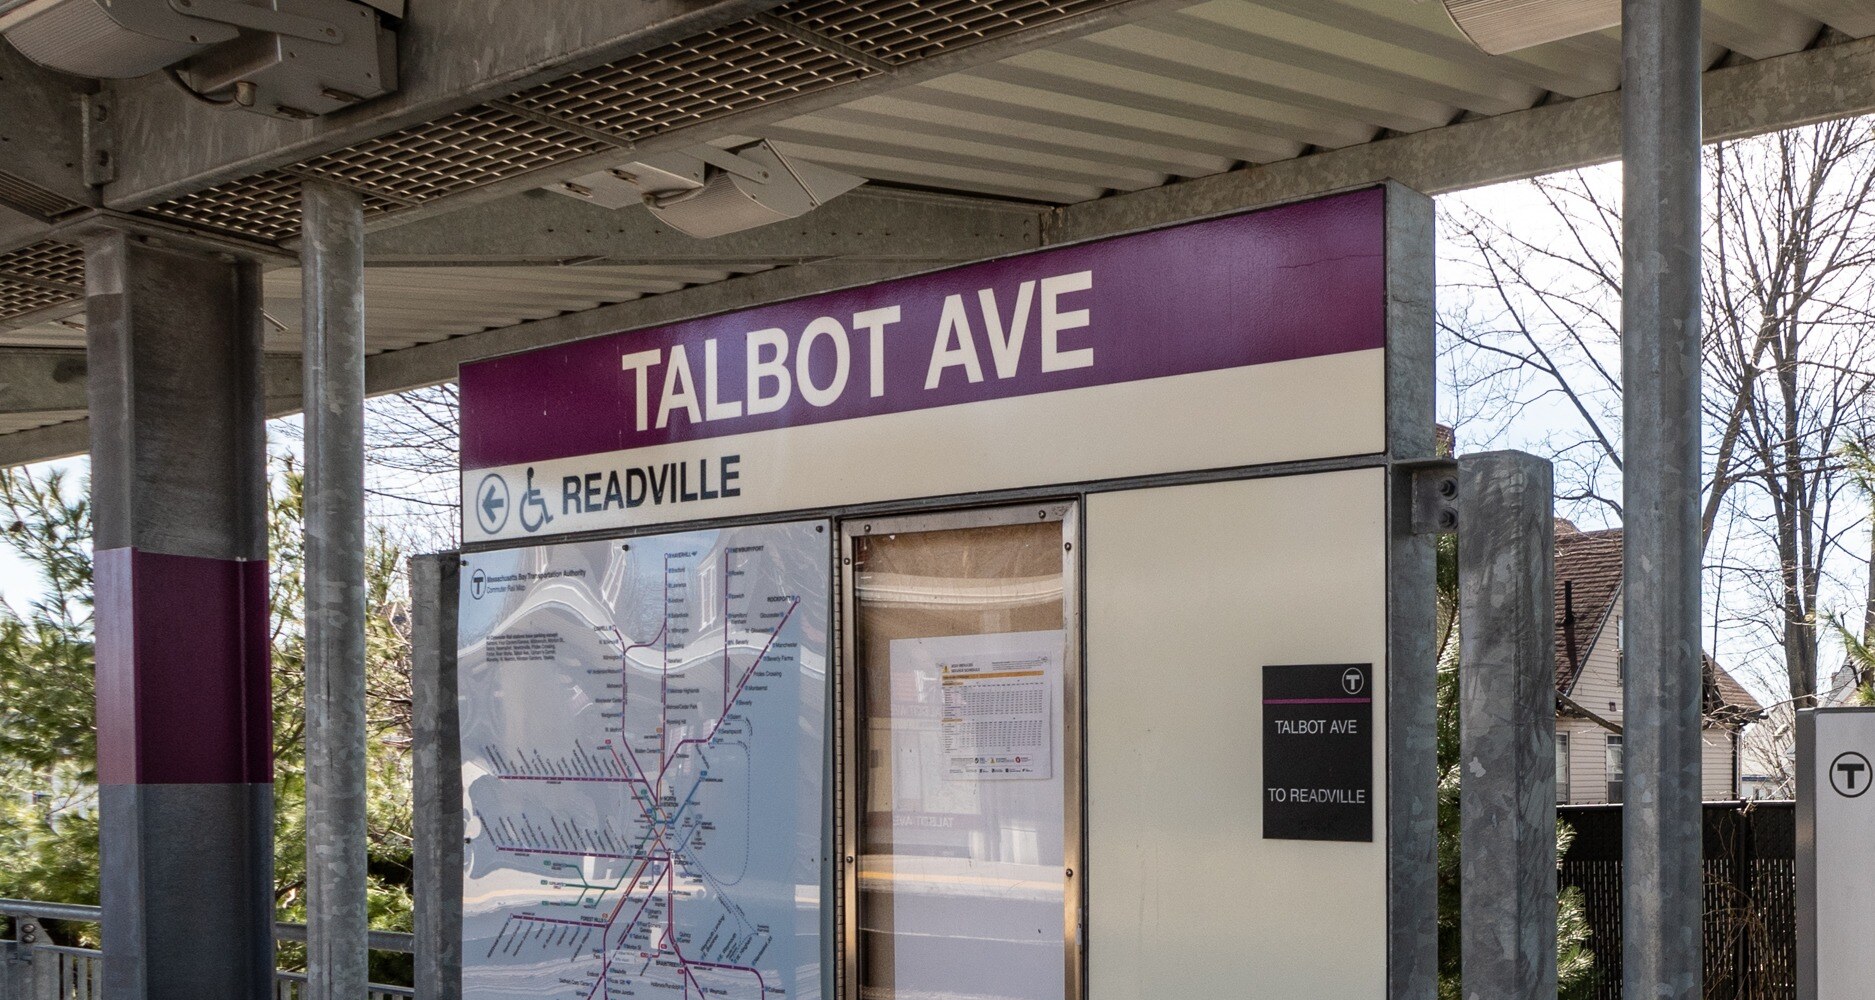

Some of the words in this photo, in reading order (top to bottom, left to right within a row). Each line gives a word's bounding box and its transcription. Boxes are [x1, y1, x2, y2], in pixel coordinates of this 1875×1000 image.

[621, 304, 901, 432] TALBOT
[923, 269, 1095, 391] AVE
[562, 454, 741, 515] READVILLE
[473, 576, 484, 595] T
[1274, 719, 1326, 735] TALBOT
[1329, 719, 1358, 734] AVE
[1267, 787, 1287, 803] TO
[1289, 788, 1366, 804] READVILLE
